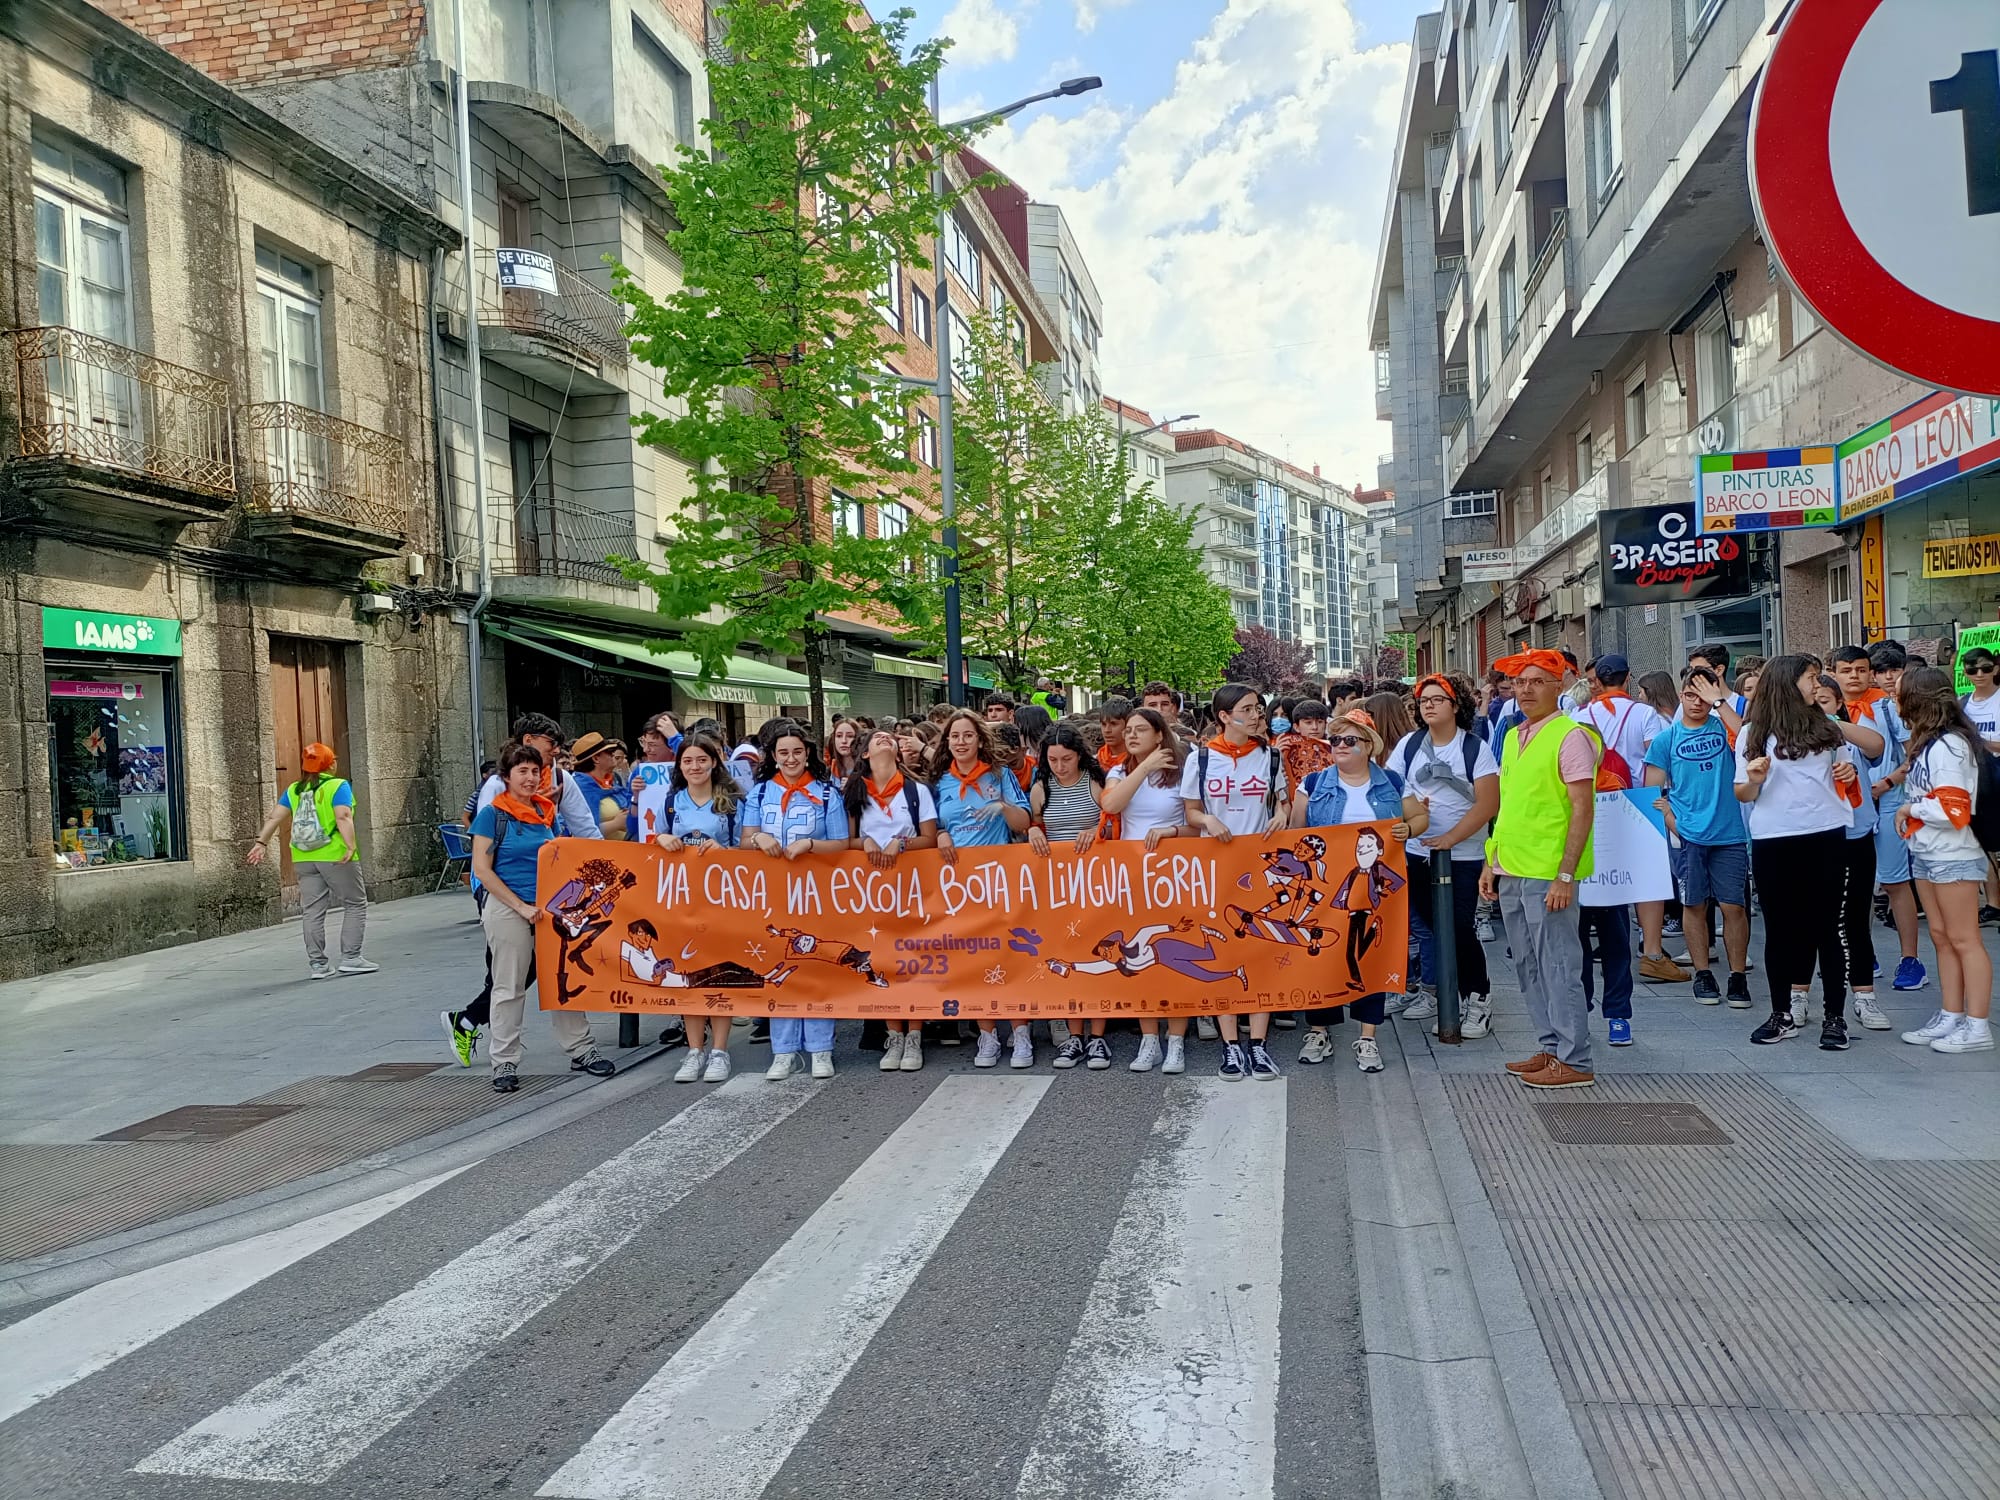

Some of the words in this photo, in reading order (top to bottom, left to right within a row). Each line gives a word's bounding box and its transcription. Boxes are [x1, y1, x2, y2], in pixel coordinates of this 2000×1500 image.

[498, 251, 515, 264] SE
[515, 251, 553, 272] VENDE
[1845, 434, 1903, 500] BARCO
[1913, 397, 1974, 471] LEON
[1721, 467, 1814, 492] PINTURAS
[1706, 492, 1768, 513] BARCO
[1777, 487, 1832, 508] LEON
[1843, 489, 1890, 518] ARMERIA
[1658, 512, 1688, 540] O
[1709, 511, 1830, 530] ARMERIA
[1466, 551, 1506, 562] ALFESO
[1925, 542, 1982, 573] TENEMOS
[1635, 560, 1716, 594] Burger
[75, 620, 138, 650] IAMS
[774, 691, 792, 705] PUB
[1680, 738, 1722, 755] HOLLISTER
[1699, 761, 1714, 772] 19
[1208, 775, 1268, 805] 약속
[704, 864, 773, 919] CASA,
[939, 861, 1011, 917] BOTA
[1019, 863, 1039, 911] A
[1142, 852, 1217, 919] FÓRA!
[894, 933, 1001, 955] correlingua
[894, 954, 950, 976] 2023
[650, 997, 676, 1007] MESA
